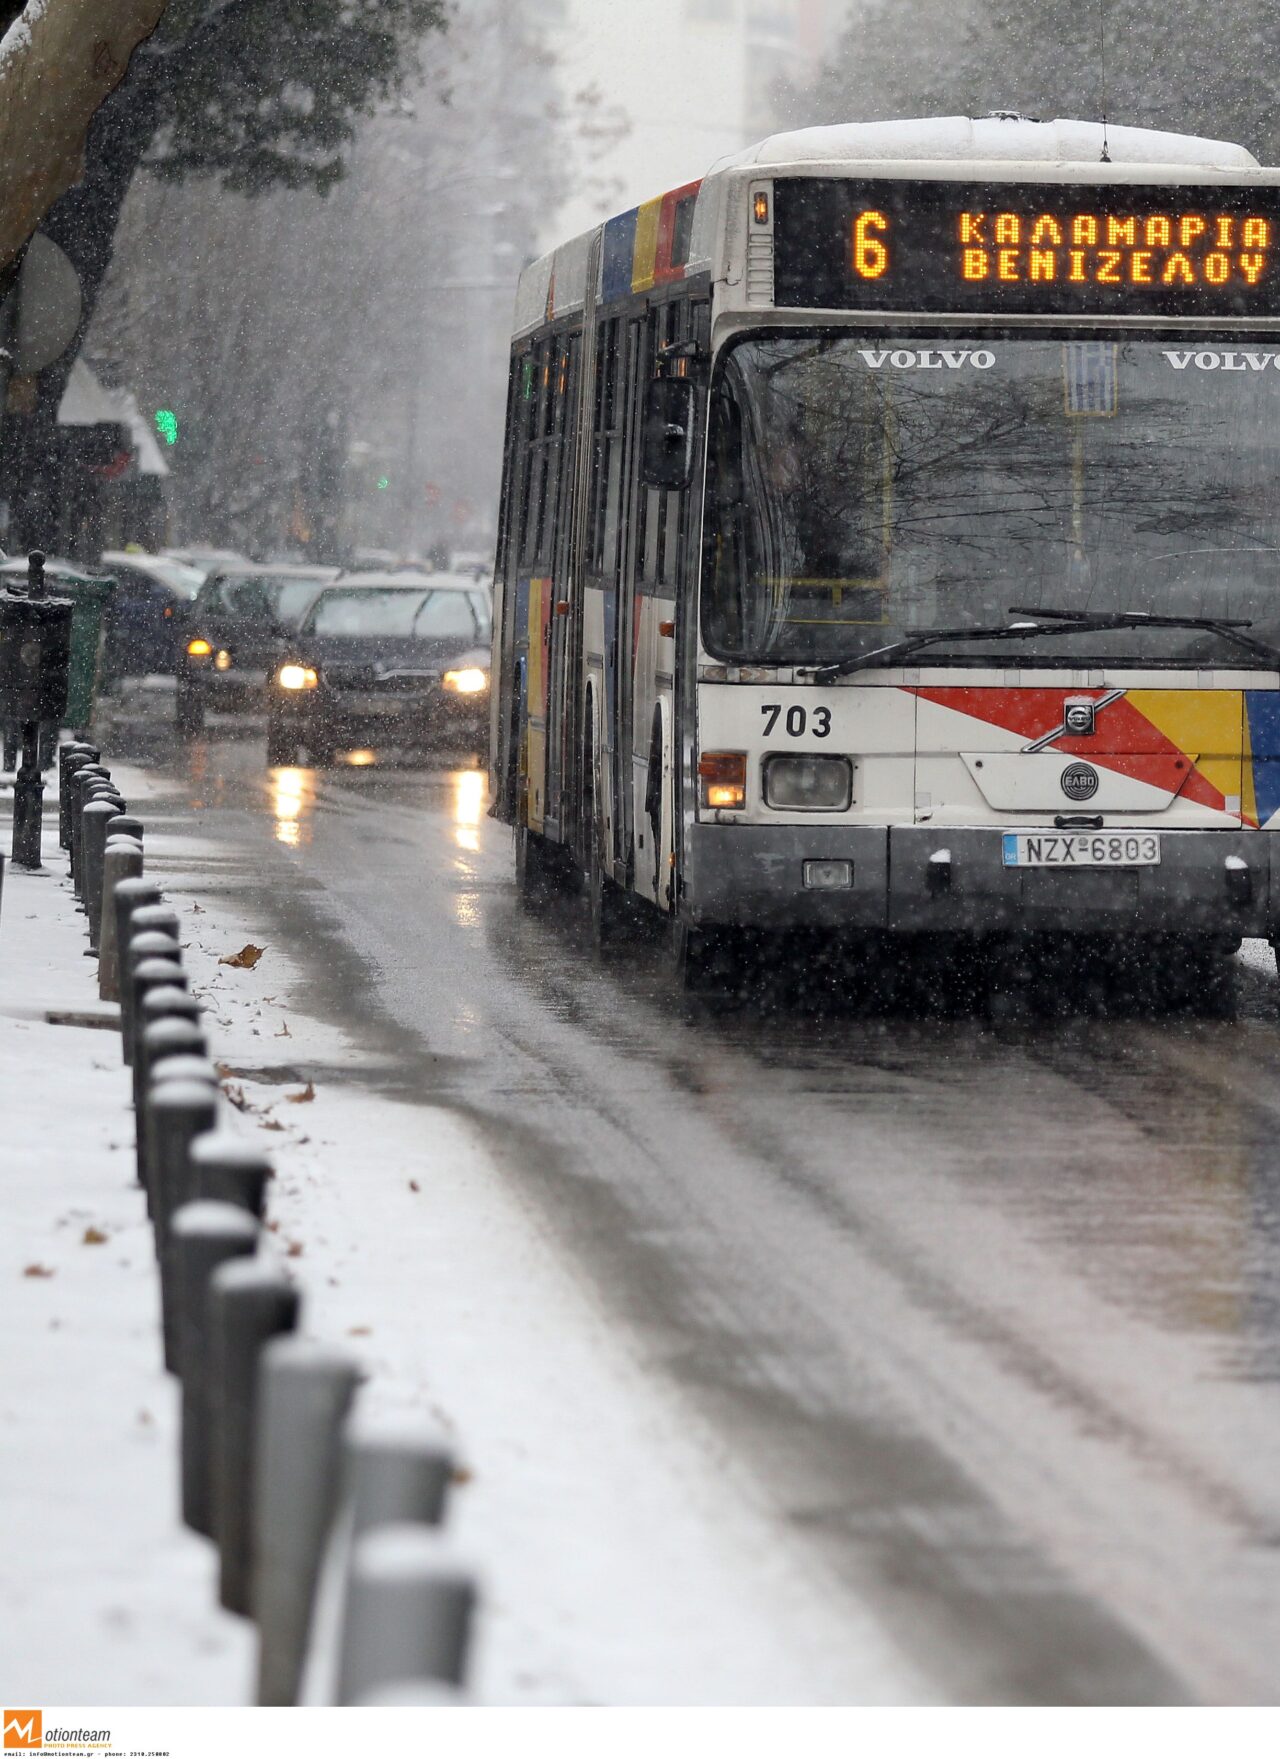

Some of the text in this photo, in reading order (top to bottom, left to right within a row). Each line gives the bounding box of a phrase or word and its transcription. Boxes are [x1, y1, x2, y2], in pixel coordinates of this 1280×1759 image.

[854, 211, 887, 279] 6
[960, 212, 1270, 247] ΚΑΛΑΜΑΡΙΑ
[963, 248, 1267, 285] ΒΕΝΙΖΕΛΟΥ
[858, 350, 996, 369] VOLVO
[761, 704, 831, 738] 703
